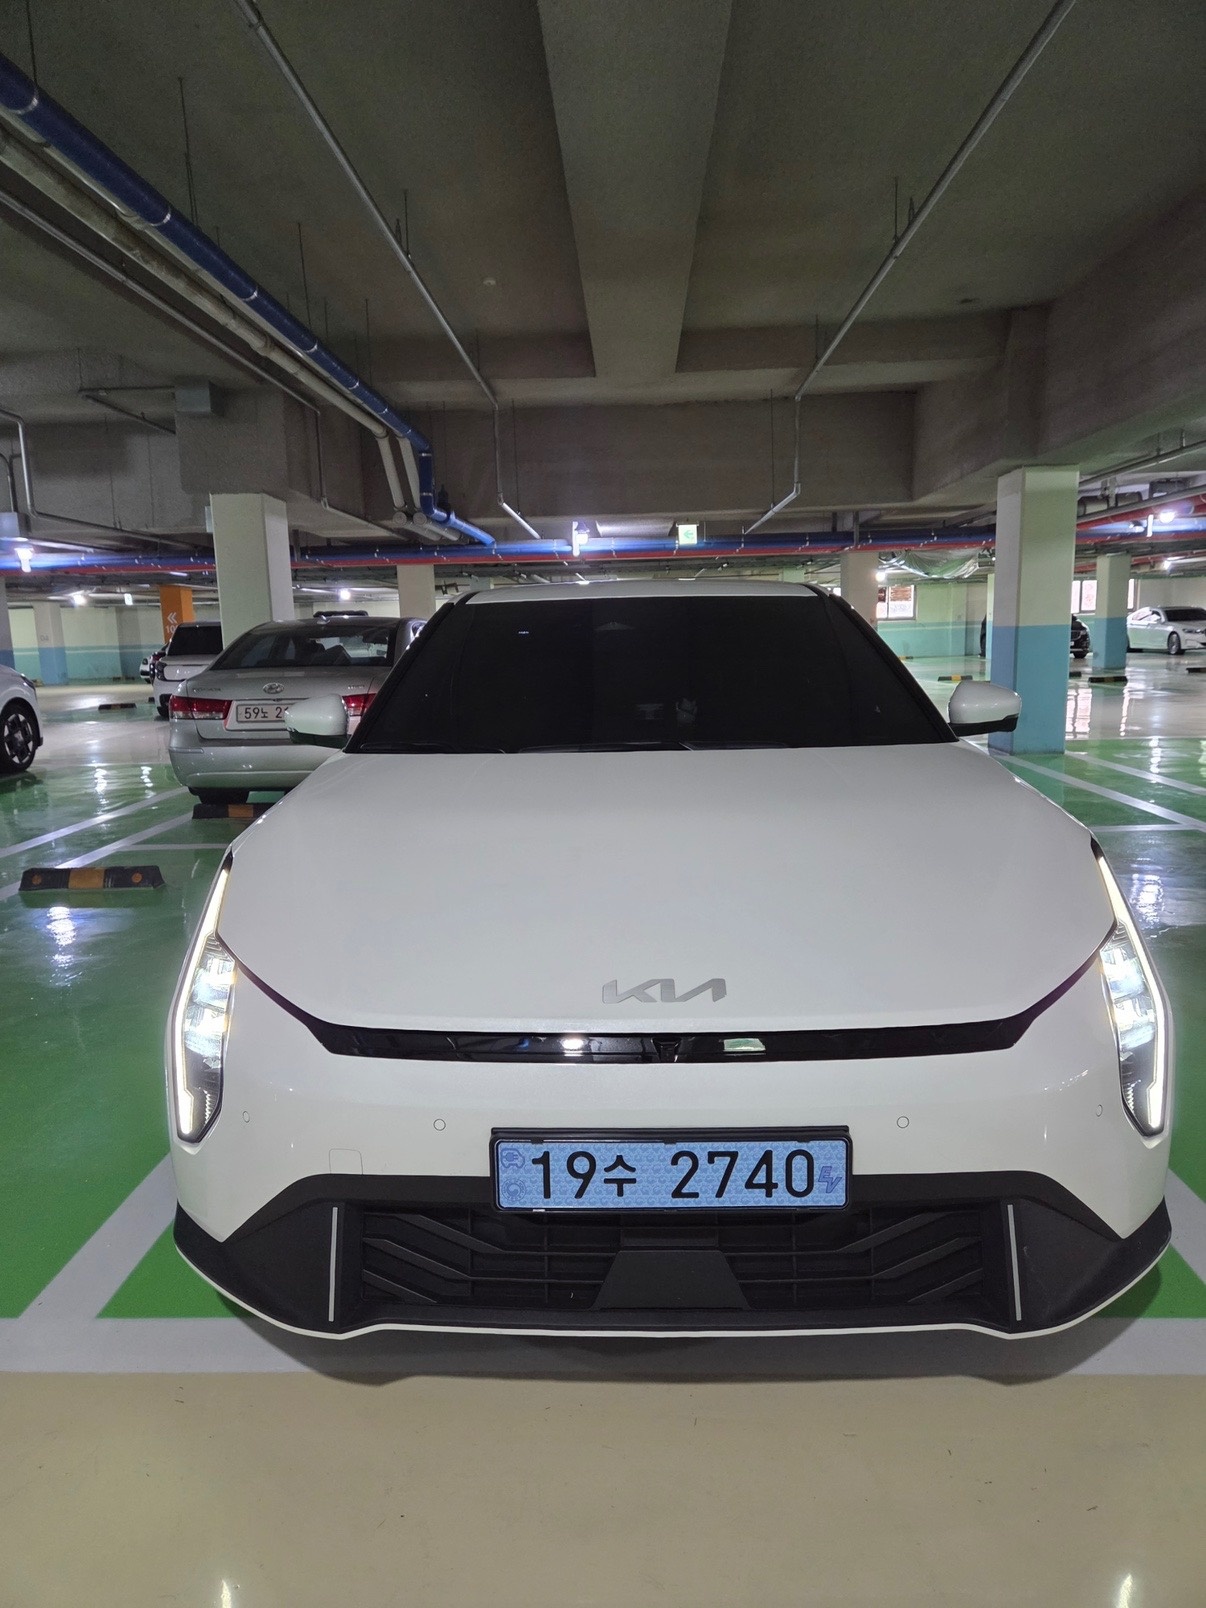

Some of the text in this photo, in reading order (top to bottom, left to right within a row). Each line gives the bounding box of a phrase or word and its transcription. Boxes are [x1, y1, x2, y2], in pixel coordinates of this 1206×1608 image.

[244, 706, 268, 719] 59노
[602, 978, 727, 1004] KIA
[531, 1150, 637, 1199] 19수
[671, 1149, 814, 1199] 2740
[818, 1166, 843, 1194] EV
